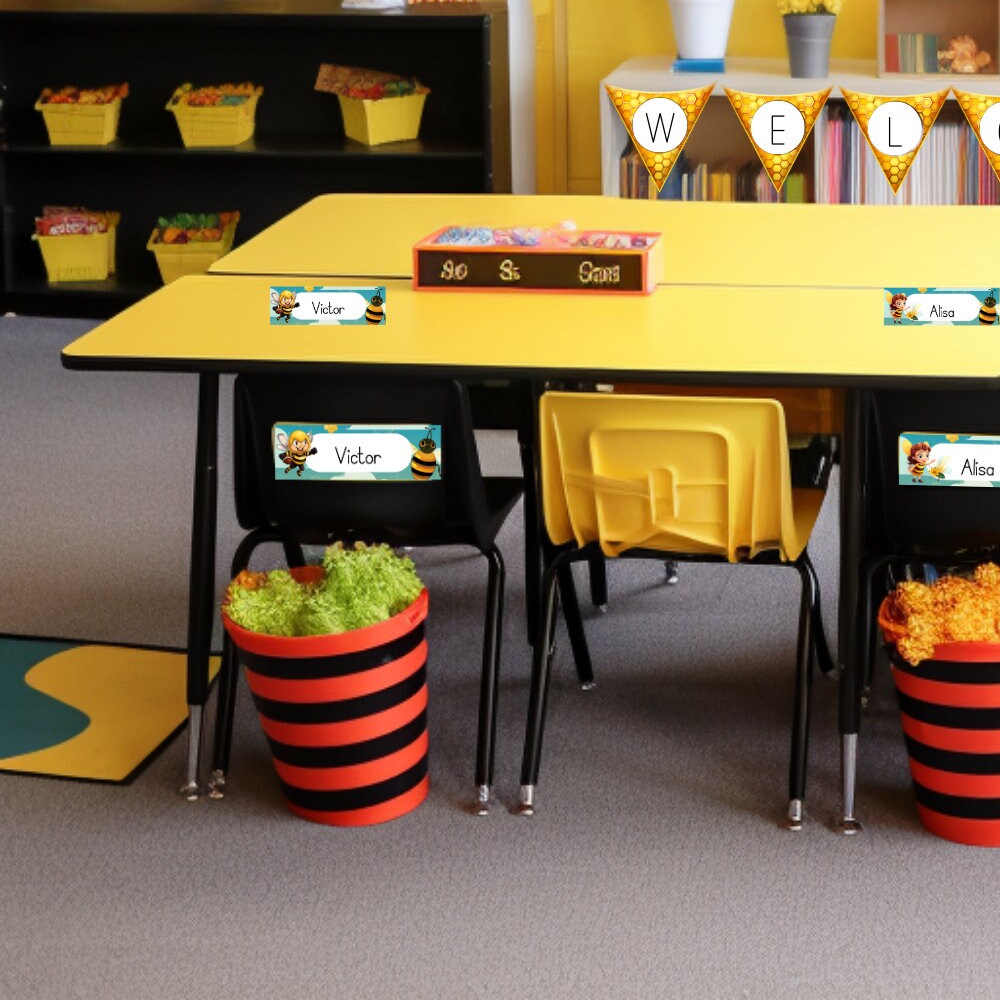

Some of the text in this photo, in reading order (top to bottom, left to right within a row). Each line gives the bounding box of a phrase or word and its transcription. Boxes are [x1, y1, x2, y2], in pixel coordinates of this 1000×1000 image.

[312, 302, 344, 314] Victor
[930, 305, 954, 317] Alisa
[335, 447, 381, 464] Victor
[961, 459, 994, 476] Alisa
